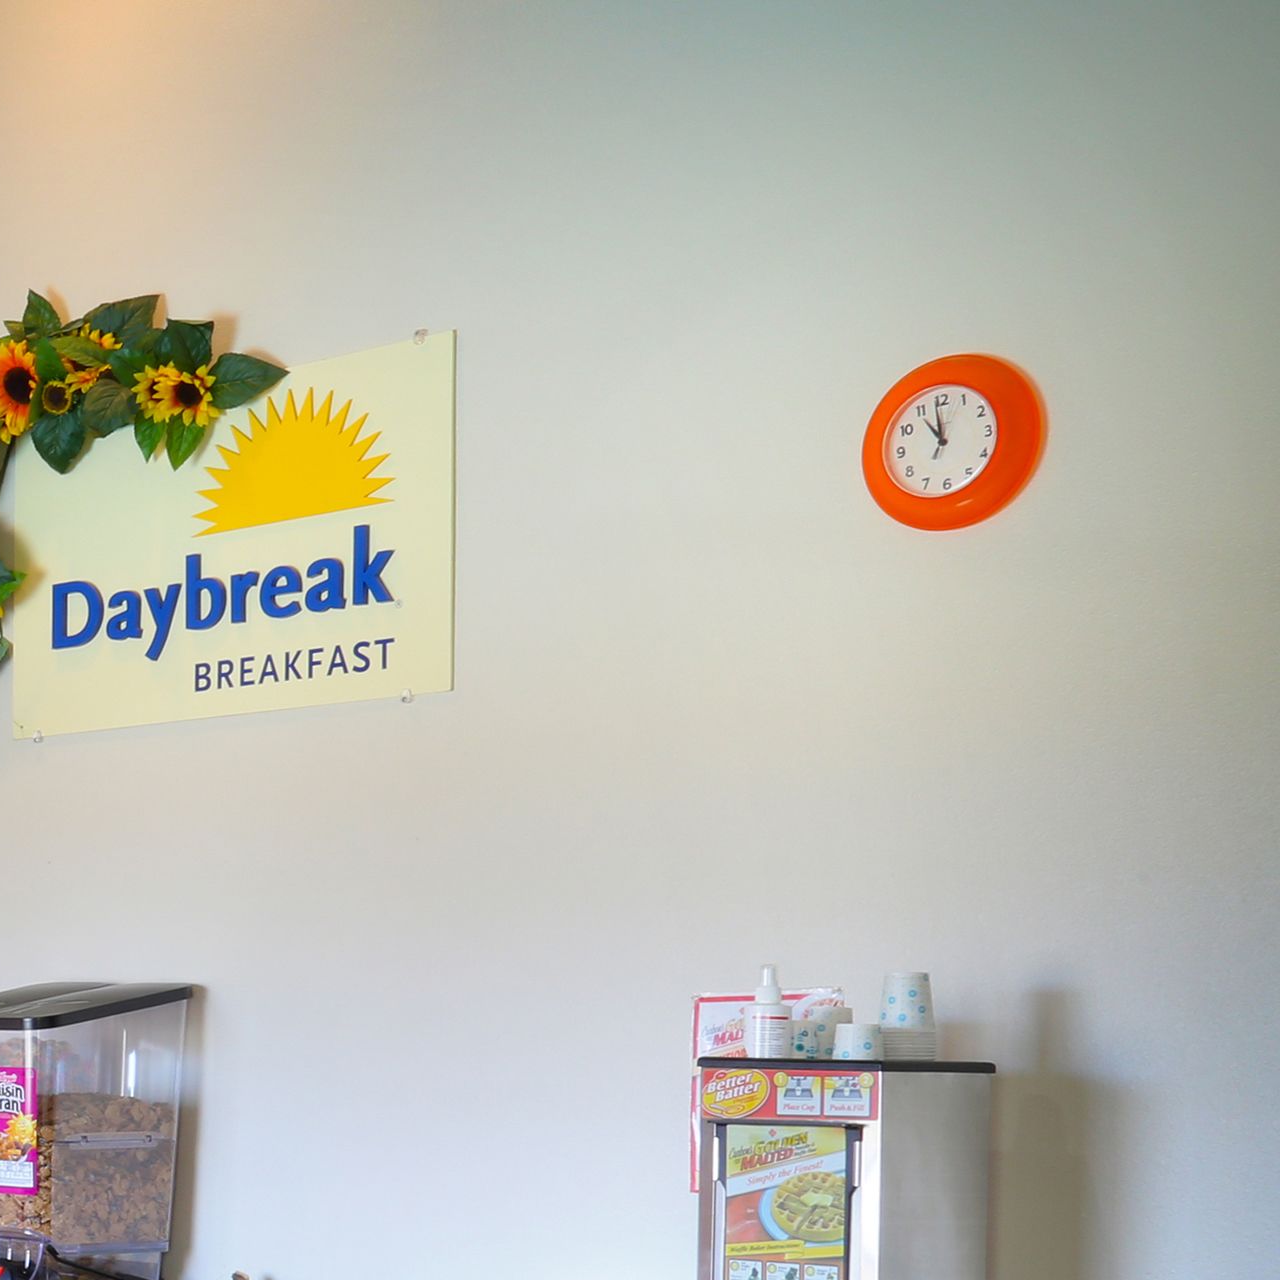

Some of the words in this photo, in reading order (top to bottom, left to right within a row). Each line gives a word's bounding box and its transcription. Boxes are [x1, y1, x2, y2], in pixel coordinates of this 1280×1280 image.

[935, 393, 949, 407] 12
[960, 394, 966, 406] 1
[916, 404, 926, 417] 11
[976, 405, 986, 418] 2
[900, 423, 914, 437] 10
[984, 425, 993, 438] 3
[896, 446, 906, 459] 9
[979, 447, 988, 459] 4
[905, 466, 915, 478] 8
[964, 467, 973, 478] 5
[922, 477, 931, 490] 7
[942, 478, 952, 491] 6
[51, 524, 395, 661] Daybreak
[193, 637, 396, 693] BREAKFAST
[707, 1072, 753, 1094] Better
[716, 1082, 760, 1102] Batter
[753, 1131, 808, 1155] GOLDEN
[741, 1147, 794, 1170] MALTED
[746, 1171, 778, 1186] Simply
[778, 1167, 792, 1178] the
[794, 1160, 824, 1175] Finest!
